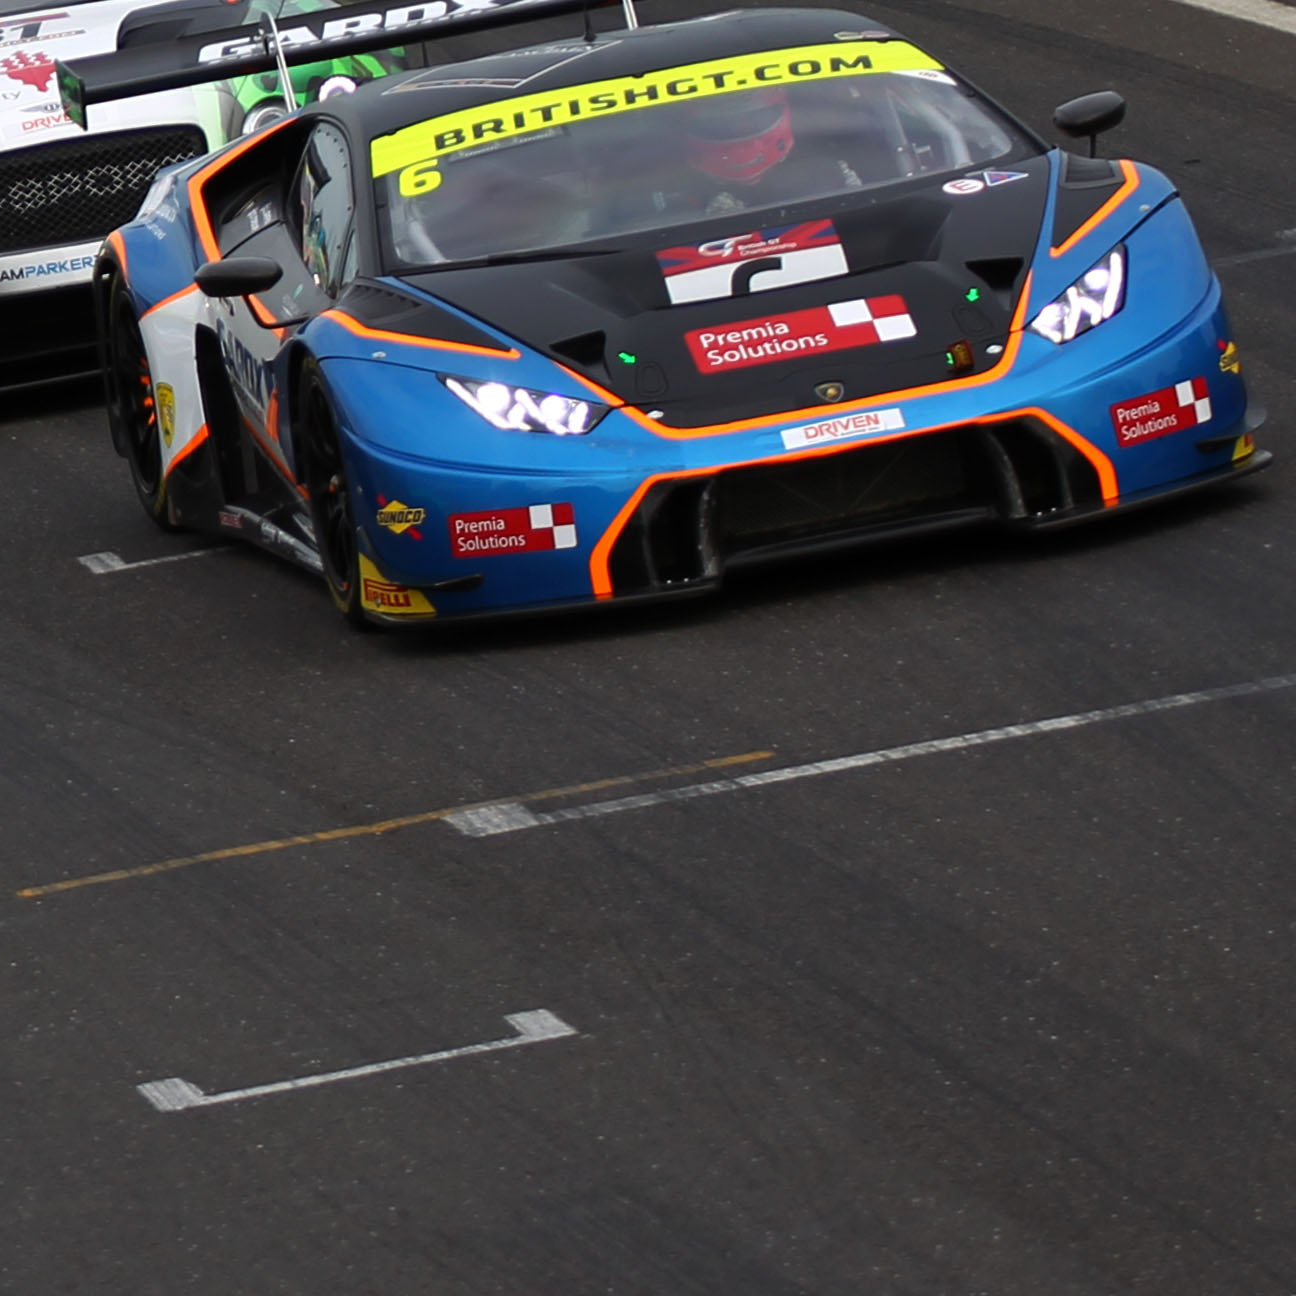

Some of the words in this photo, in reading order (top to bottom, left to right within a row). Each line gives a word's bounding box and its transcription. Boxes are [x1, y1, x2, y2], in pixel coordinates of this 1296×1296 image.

[432, 50, 875, 152] BRITISHGT.COM
[22, 112, 74, 132] DRIVE
[396, 158, 442, 196] 6
[698, 320, 790, 349] Premia
[706, 332, 829, 367] Solutions
[1116, 399, 1161, 424] Premia
[803, 413, 880, 441] DRIVEN
[1120, 411, 1178, 441] Solutions
[377, 507, 425, 525] SUNOCO
[454, 515, 506, 534] Premia
[457, 532, 527, 552] Solutions
[363, 577, 412, 607] PIRELLI
